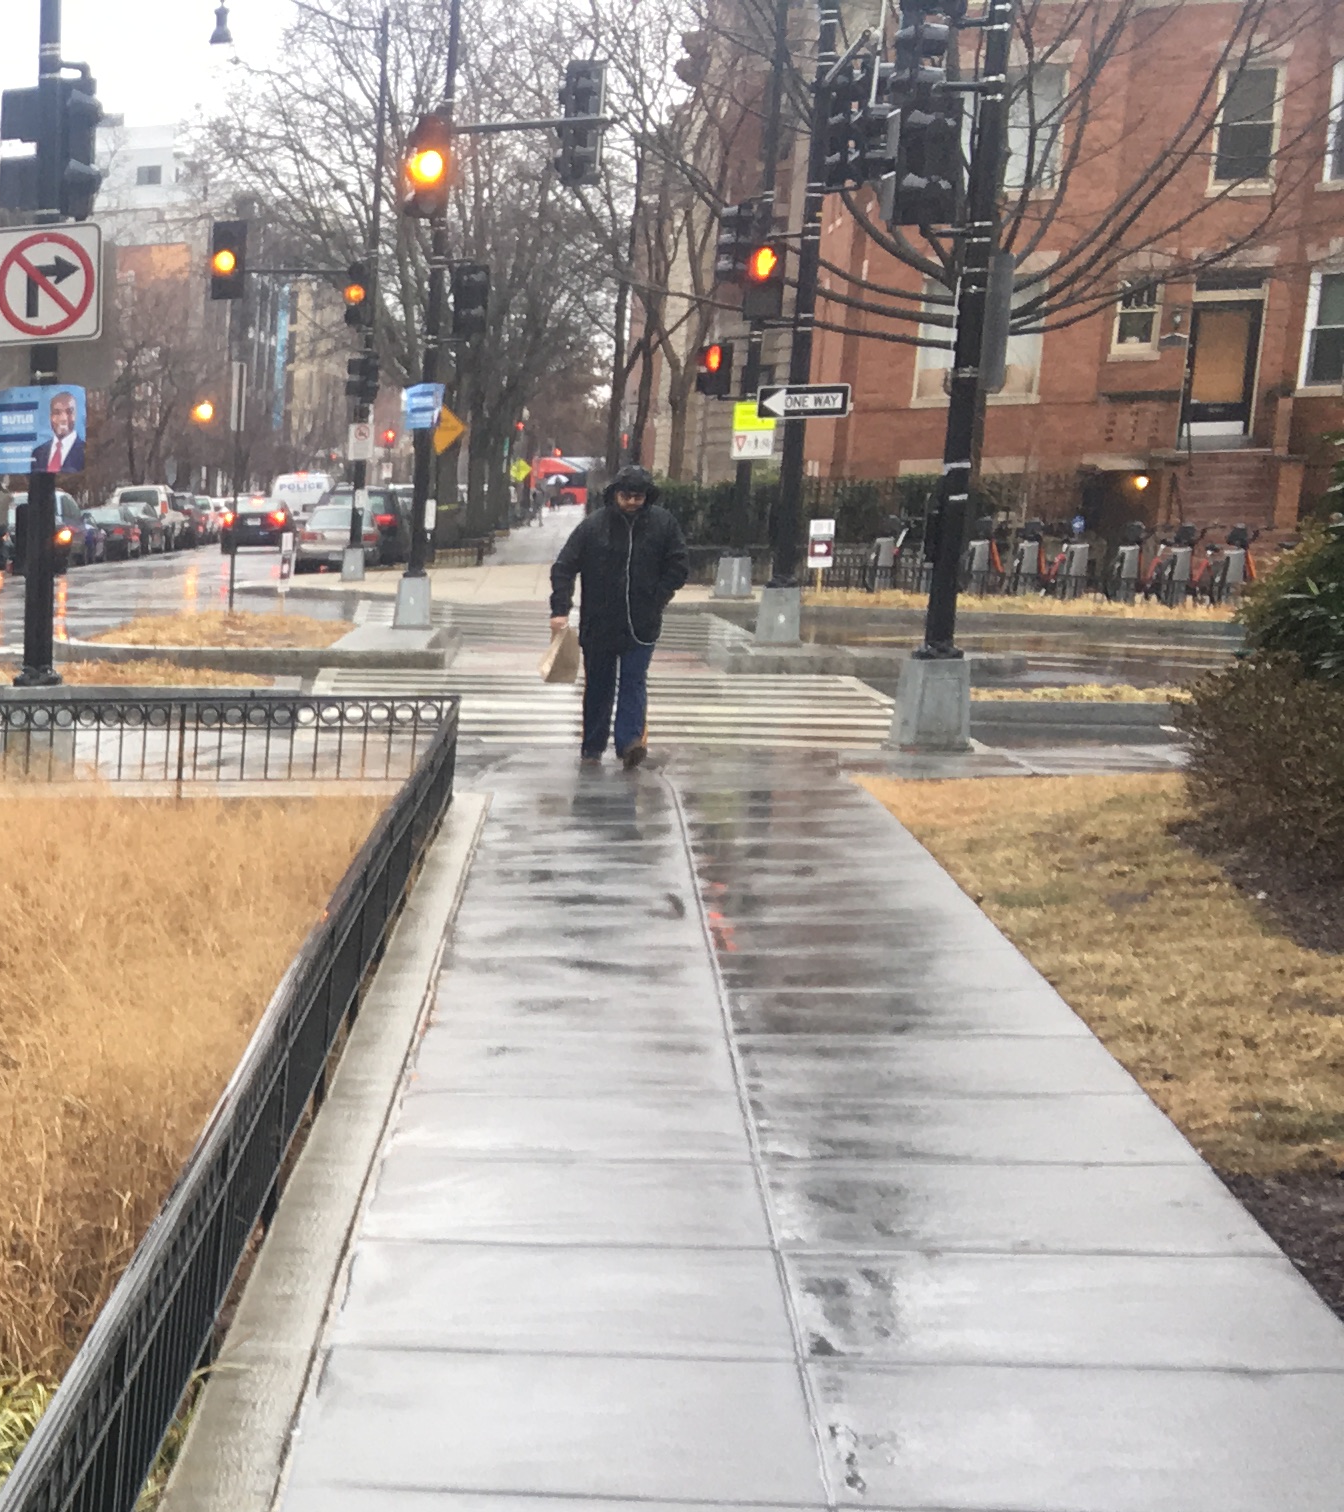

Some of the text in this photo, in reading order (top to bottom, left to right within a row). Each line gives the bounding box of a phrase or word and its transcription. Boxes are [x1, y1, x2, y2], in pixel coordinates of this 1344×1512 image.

[784, 394, 839, 409] ONE WAY
[279, 482, 323, 492] POLICE
